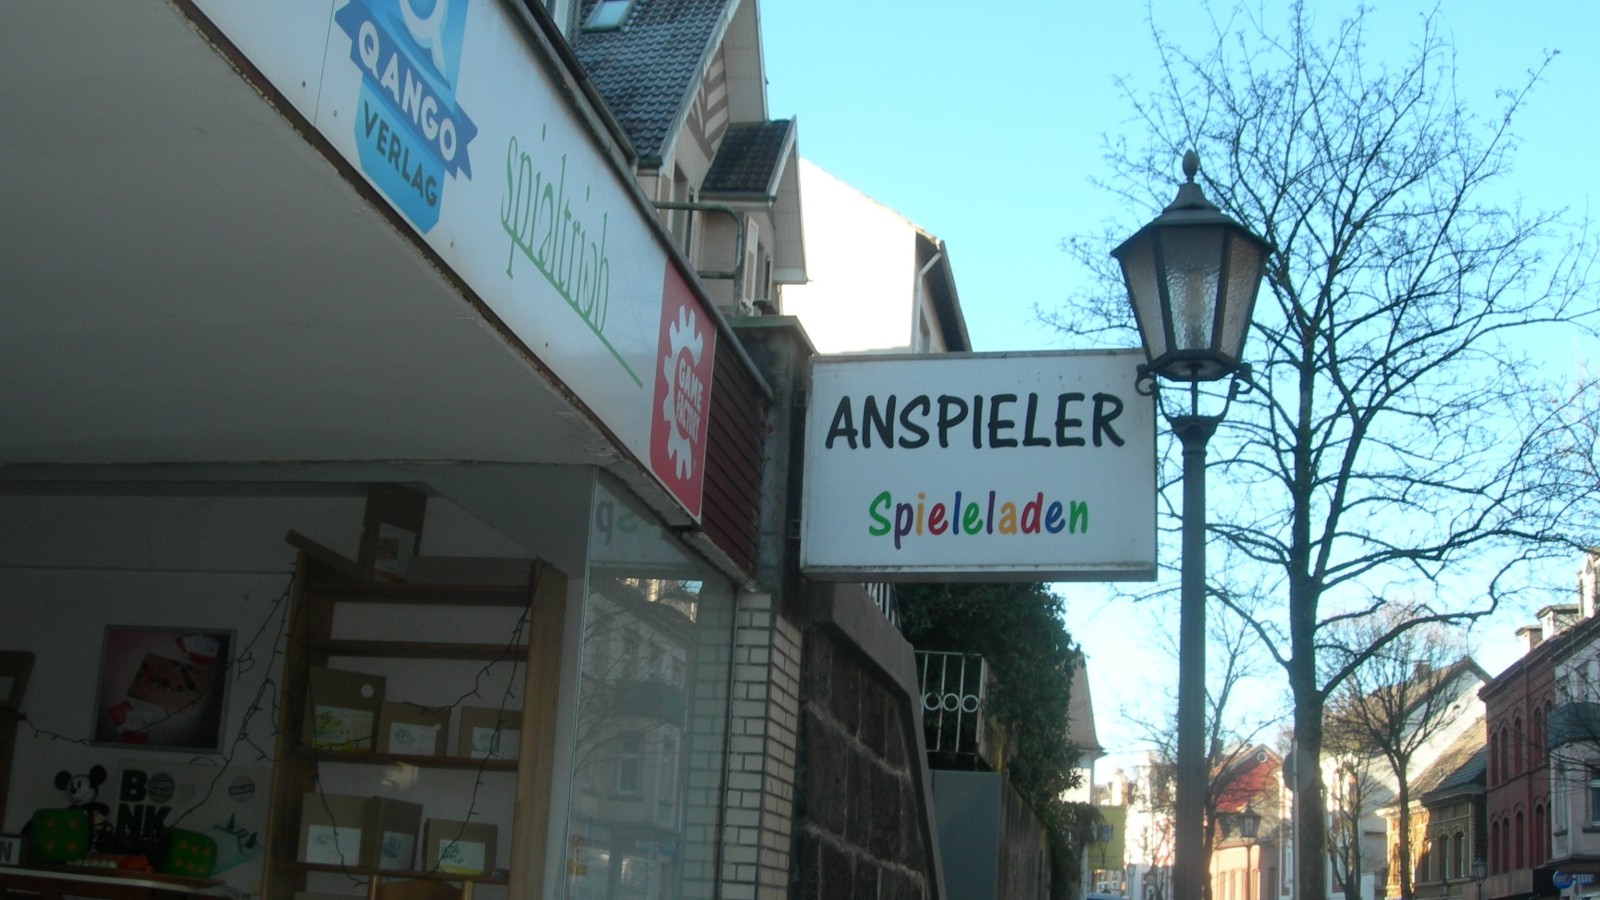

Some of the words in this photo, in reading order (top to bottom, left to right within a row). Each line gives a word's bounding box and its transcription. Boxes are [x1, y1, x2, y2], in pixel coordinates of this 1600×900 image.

[358, 20, 457, 161] QANGO
[363, 100, 438, 207] VERLAG
[679, 358, 703, 412] GAME
[825, 392, 1125, 449] ANSPIELER
[868, 490, 1089, 550] Spieleladen
